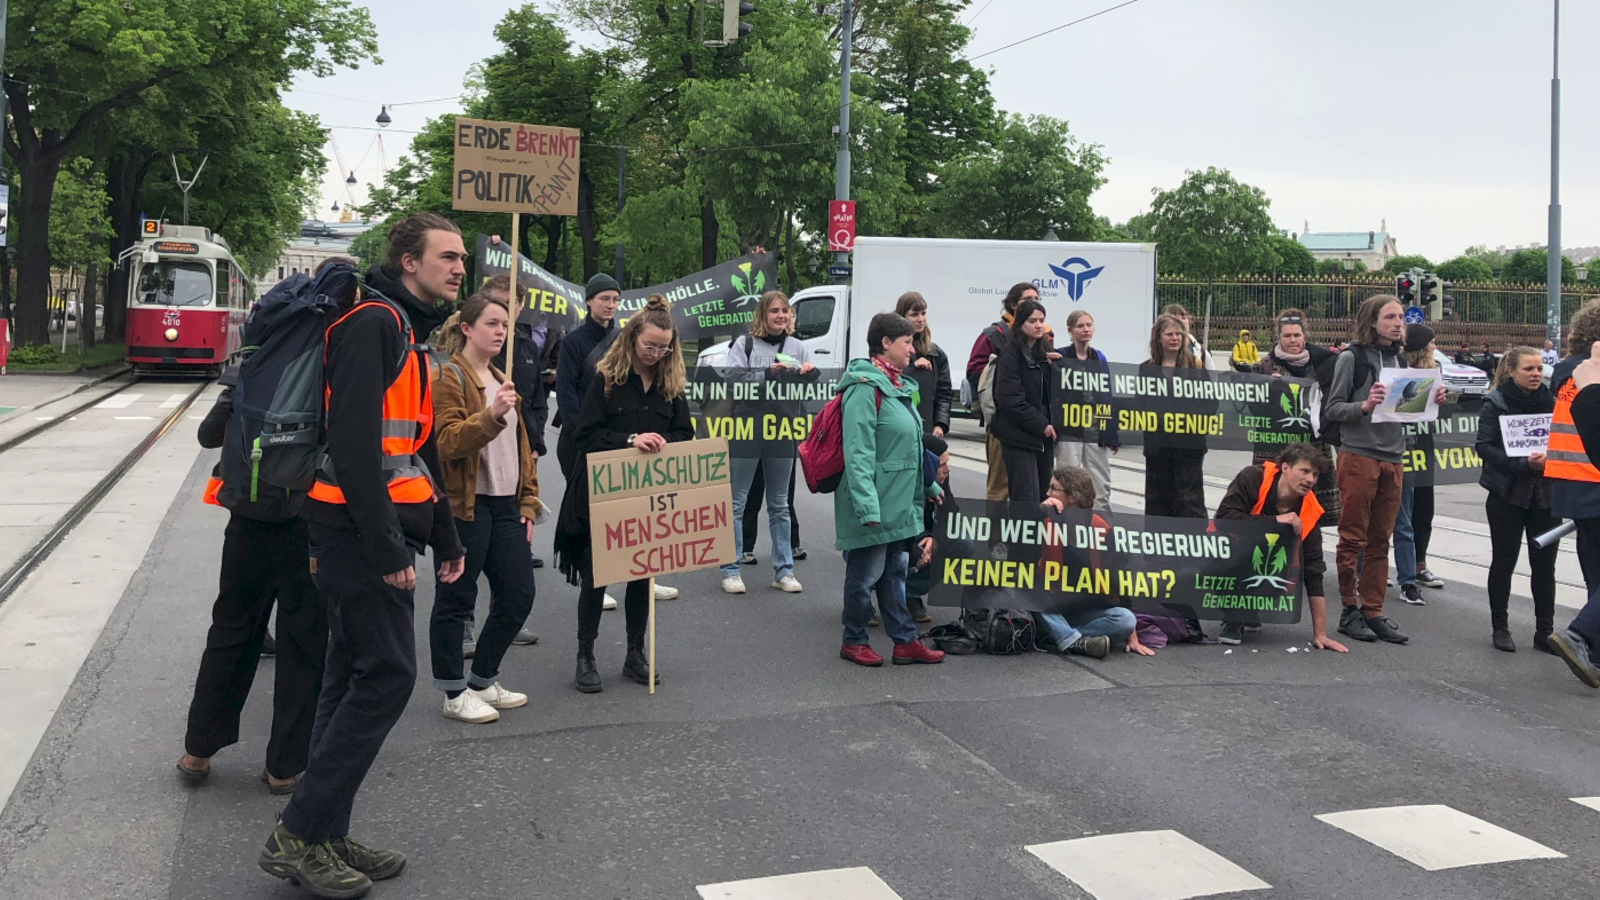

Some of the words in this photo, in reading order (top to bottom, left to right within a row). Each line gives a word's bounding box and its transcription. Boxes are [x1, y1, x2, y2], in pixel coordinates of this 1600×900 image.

[459, 124, 511, 150] ERDE
[516, 125, 579, 158] BRENNT
[458, 169, 536, 204] POLITIK
[533, 152, 576, 213] PENNT
[146, 222, 155, 232] 2
[968, 287, 993, 295] Global
[1031, 278, 1059, 289] GLM
[683, 299, 725, 317] LETZTE
[710, 382, 728, 400] IN
[733, 382, 760, 400] DIE
[1061, 367, 1110, 393] KEINE
[1114, 374, 1168, 397] NEUEN
[1172, 376, 1270, 403] BOHRUNGEN!
[706, 416, 754, 440] VOM
[1062, 403, 1093, 428] 100
[1095, 404, 1111, 416] KM
[1118, 409, 1158, 432] SIND
[1163, 412, 1224, 436] GENUG!
[1239, 414, 1272, 429] LETZTE
[1435, 418, 1453, 434] IN
[592, 451, 727, 495] KLIMASCHUTZ
[650, 492, 678, 512] IST
[947, 512, 991, 541] UND
[1001, 518, 1068, 547] WENN
[1075, 524, 1108, 551] DIE
[1113, 526, 1231, 560] REGIERUNG
[629, 537, 720, 576] SCHUTZ
[943, 558, 1035, 590] KEINEN
[1044, 560, 1110, 595] PLAN
[1118, 569, 1176, 599] HAT?
[1195, 573, 1237, 590] LETZTE
[1202, 592, 1295, 612] GENERATION.AT
